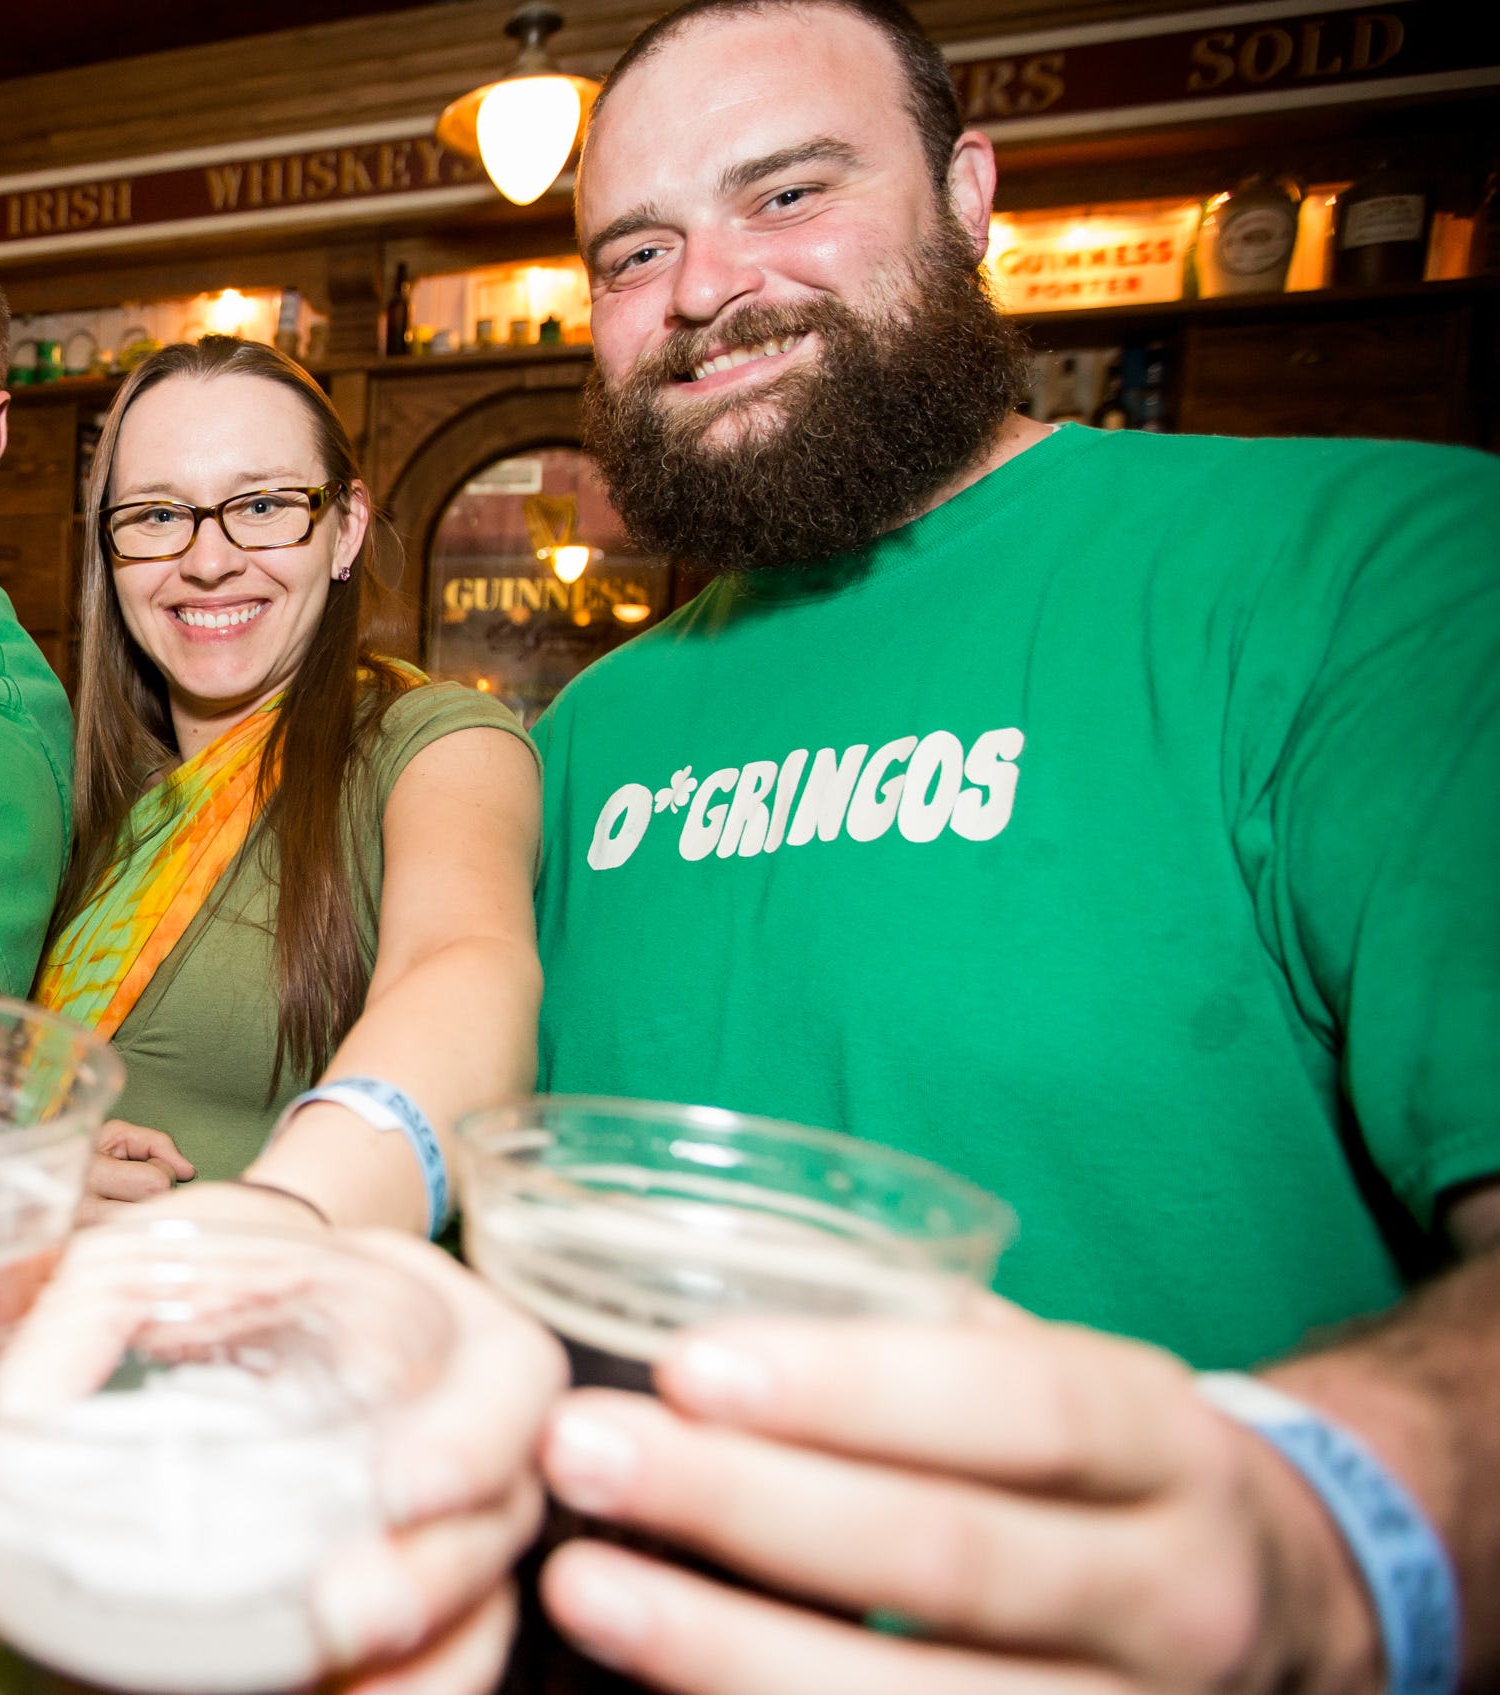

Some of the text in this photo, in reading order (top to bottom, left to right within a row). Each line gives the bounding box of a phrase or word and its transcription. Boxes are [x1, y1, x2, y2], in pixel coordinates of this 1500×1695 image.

[1187, 13, 1405, 92] SOLD
[5, 181, 132, 236] IRISH
[997, 239, 1174, 275] GUINNESS
[1026, 275, 1142, 298] PORTER
[443, 577, 650, 612] GUINNESS
